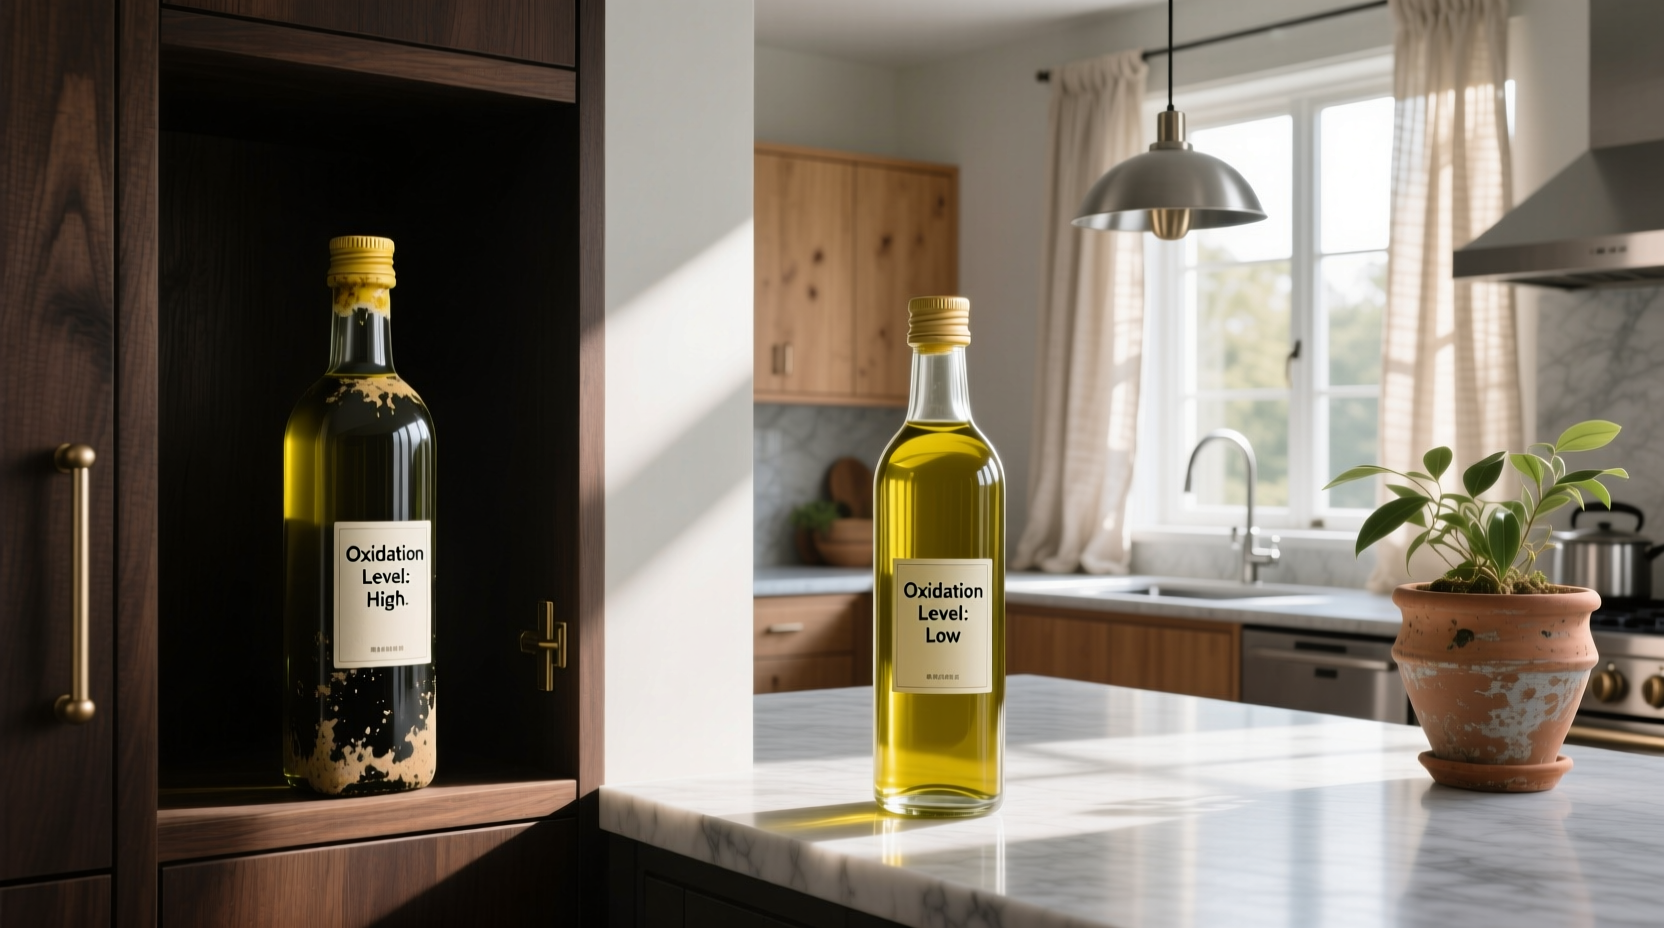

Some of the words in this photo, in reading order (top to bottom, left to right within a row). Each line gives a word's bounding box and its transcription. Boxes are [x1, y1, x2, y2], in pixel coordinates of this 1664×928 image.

[346, 545, 424, 562] Oxidation
[362, 568, 410, 584] Level:
[904, 582, 983, 598] Oxidation
[367, 590, 409, 611] High.
[918, 605, 968, 621] Level:
[926, 627, 961, 643] Low
